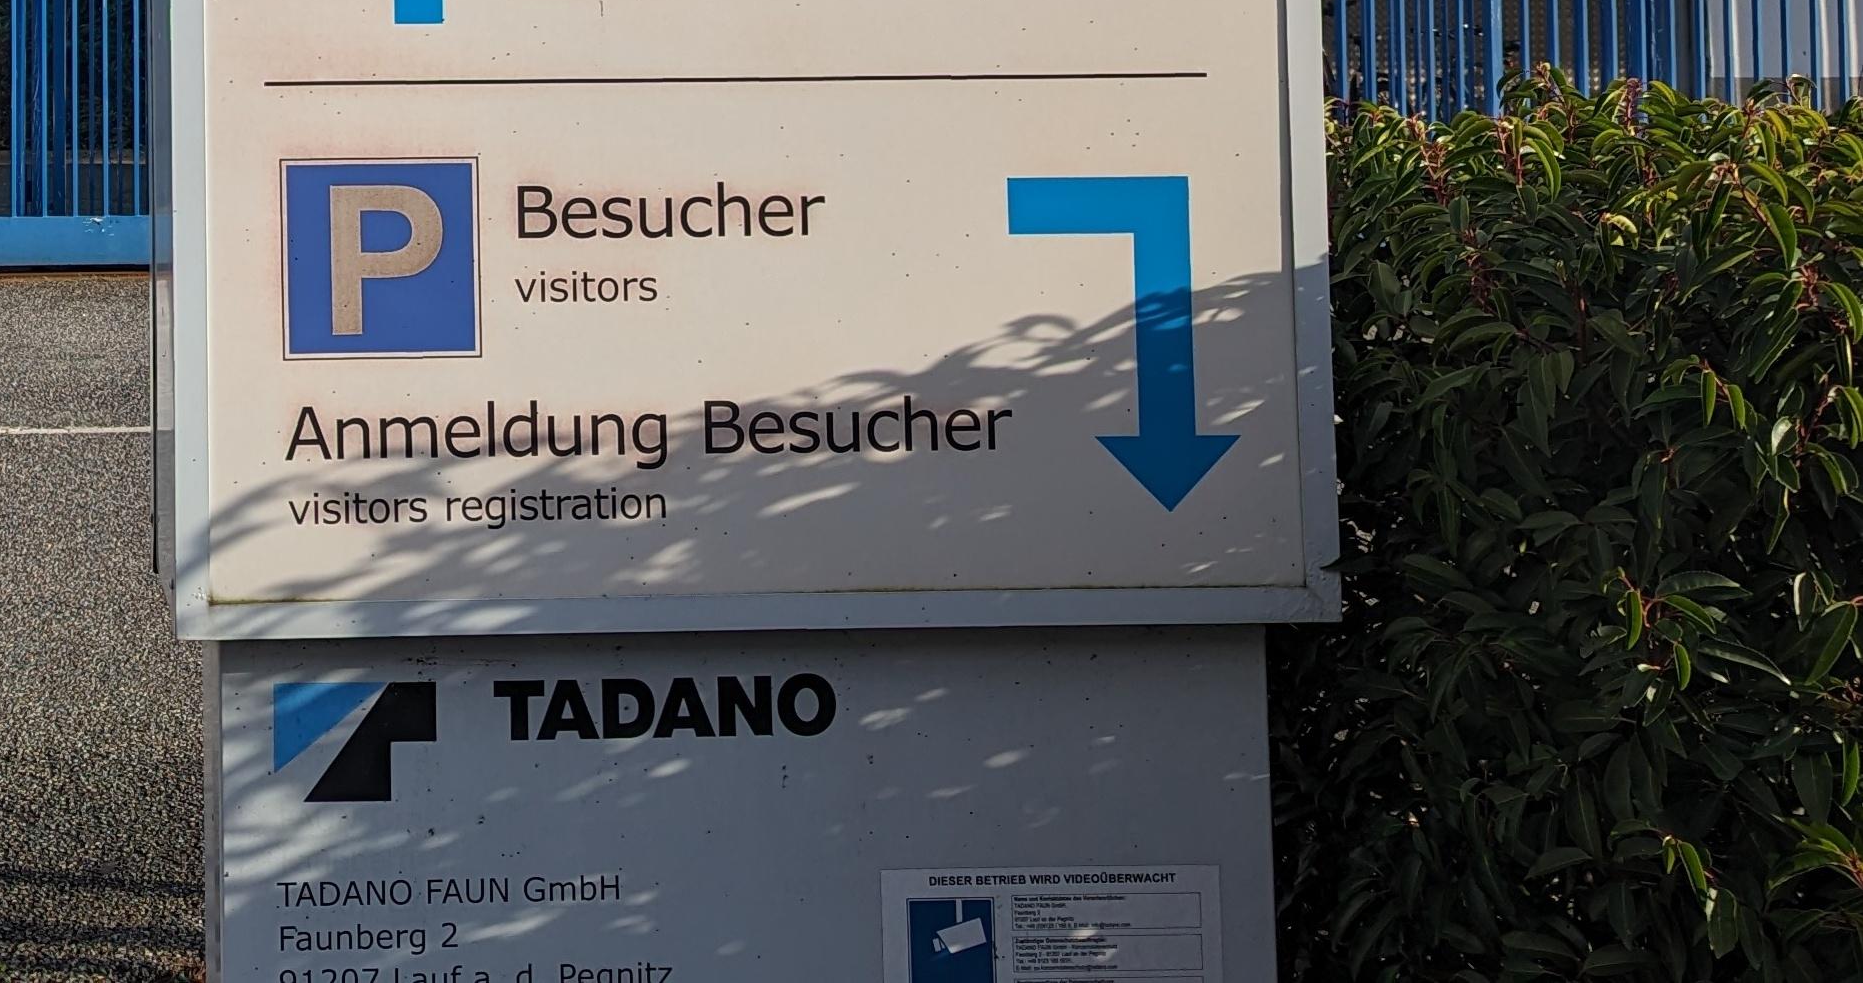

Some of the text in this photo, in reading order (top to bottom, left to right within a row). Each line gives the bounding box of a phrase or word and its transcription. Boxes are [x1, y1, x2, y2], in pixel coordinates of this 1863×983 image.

[517, 181, 826, 239] Besucher
[329, 184, 445, 336] P
[514, 271, 659, 303] visitors
[285, 395, 1013, 470] Anmeldung Besucher
[288, 488, 668, 530] visitors registration
[493, 672, 837, 741] TADANO
[277, 874, 622, 908] TADANO FAUN GmbH
[928, 871, 1177, 887] DIESER BETRIEB WIRD VIDEOÜBERWACHT
[279, 922, 460, 956] Faunberg 2
